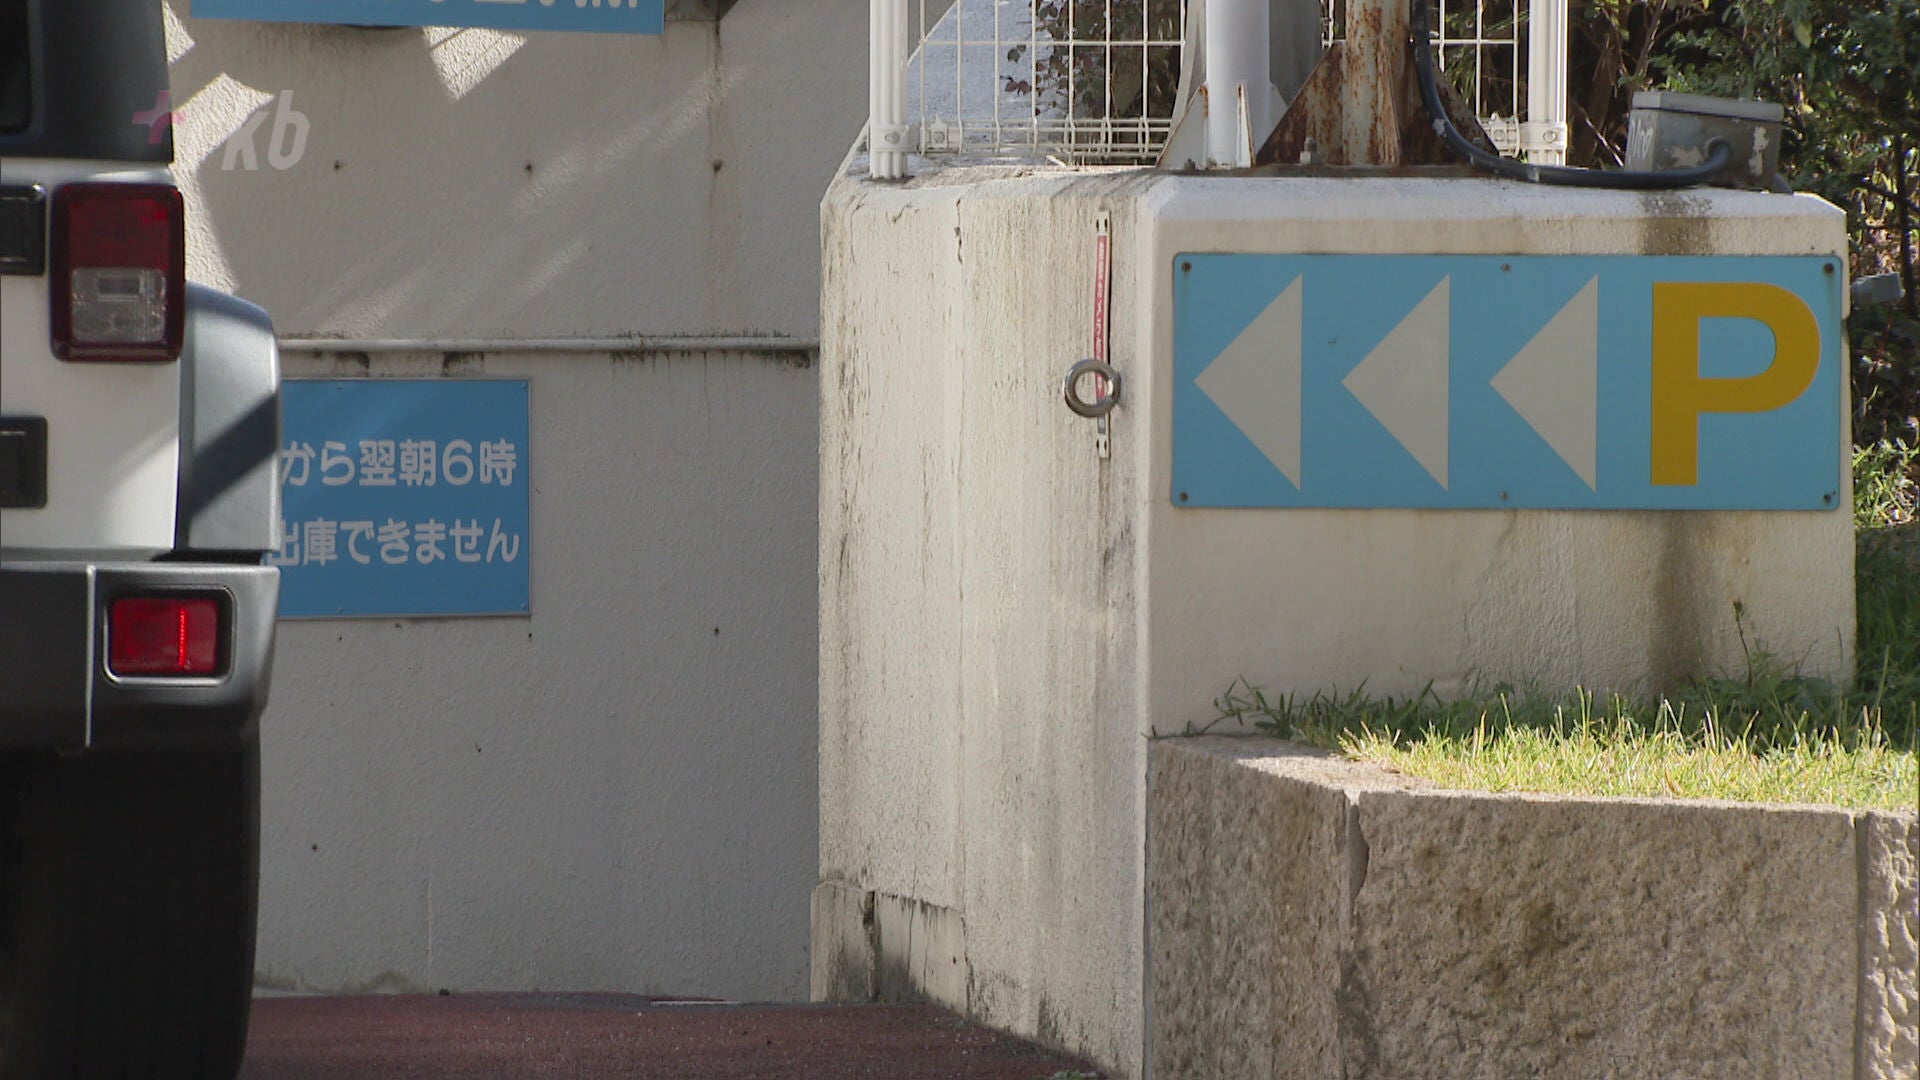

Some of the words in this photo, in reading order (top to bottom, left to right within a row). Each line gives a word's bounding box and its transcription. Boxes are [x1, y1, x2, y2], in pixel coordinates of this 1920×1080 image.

[1651, 281, 1822, 486] P
[281, 438, 517, 487] から翌朝6時
[268, 517, 520, 566] 出庫できません
